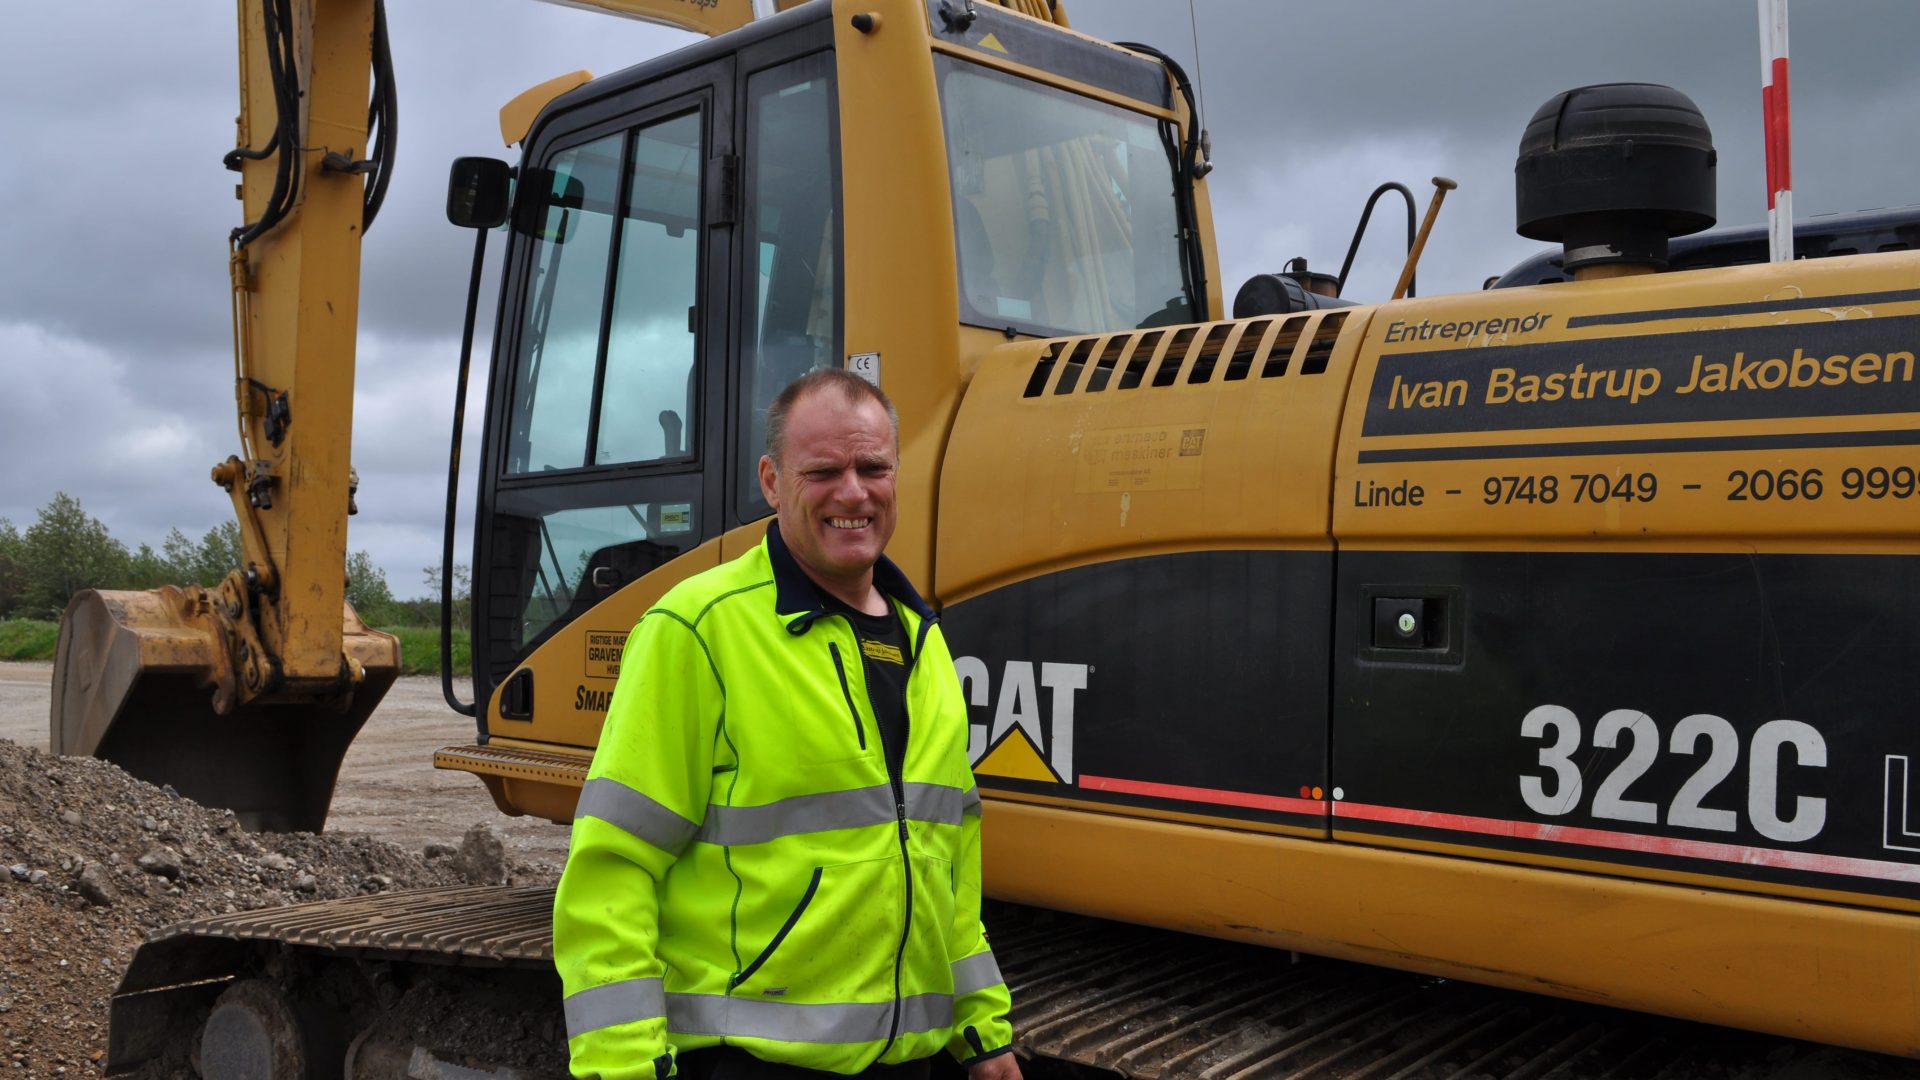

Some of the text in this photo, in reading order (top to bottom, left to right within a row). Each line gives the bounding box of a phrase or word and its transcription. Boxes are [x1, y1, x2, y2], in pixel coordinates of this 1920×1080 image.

[1384, 312, 1552, 343] Entreprenør
[1387, 348, 1915, 410] Ivan Bastrup Jakobsen
[1354, 479, 1425, 507] Linde
[1483, 476, 1559, 505] 9748
[1570, 472, 1658, 504] 7049
[1727, 468, 1823, 501] 2066
[1841, 466, 1920, 500] 999
[1519, 704, 1828, 843] 322C
